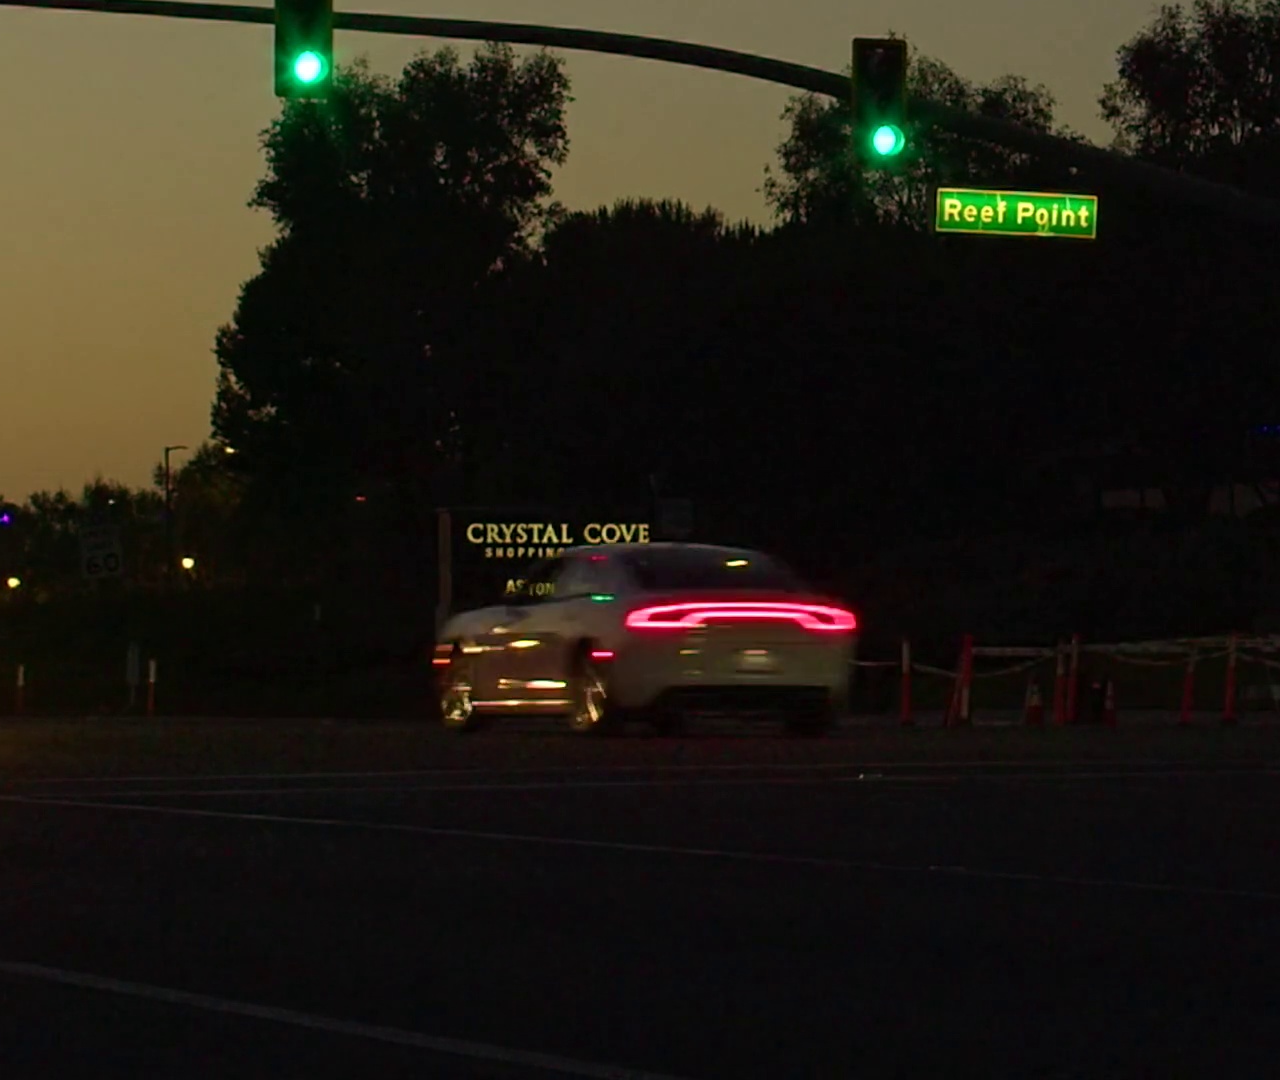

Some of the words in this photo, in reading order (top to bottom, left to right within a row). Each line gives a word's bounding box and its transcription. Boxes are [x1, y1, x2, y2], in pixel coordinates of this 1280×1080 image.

[943, 198, 1007, 224] Reef
[1016, 201, 1089, 228] Point
[466, 522, 574, 544] CRYSTAL
[583, 522, 651, 544] COVE
